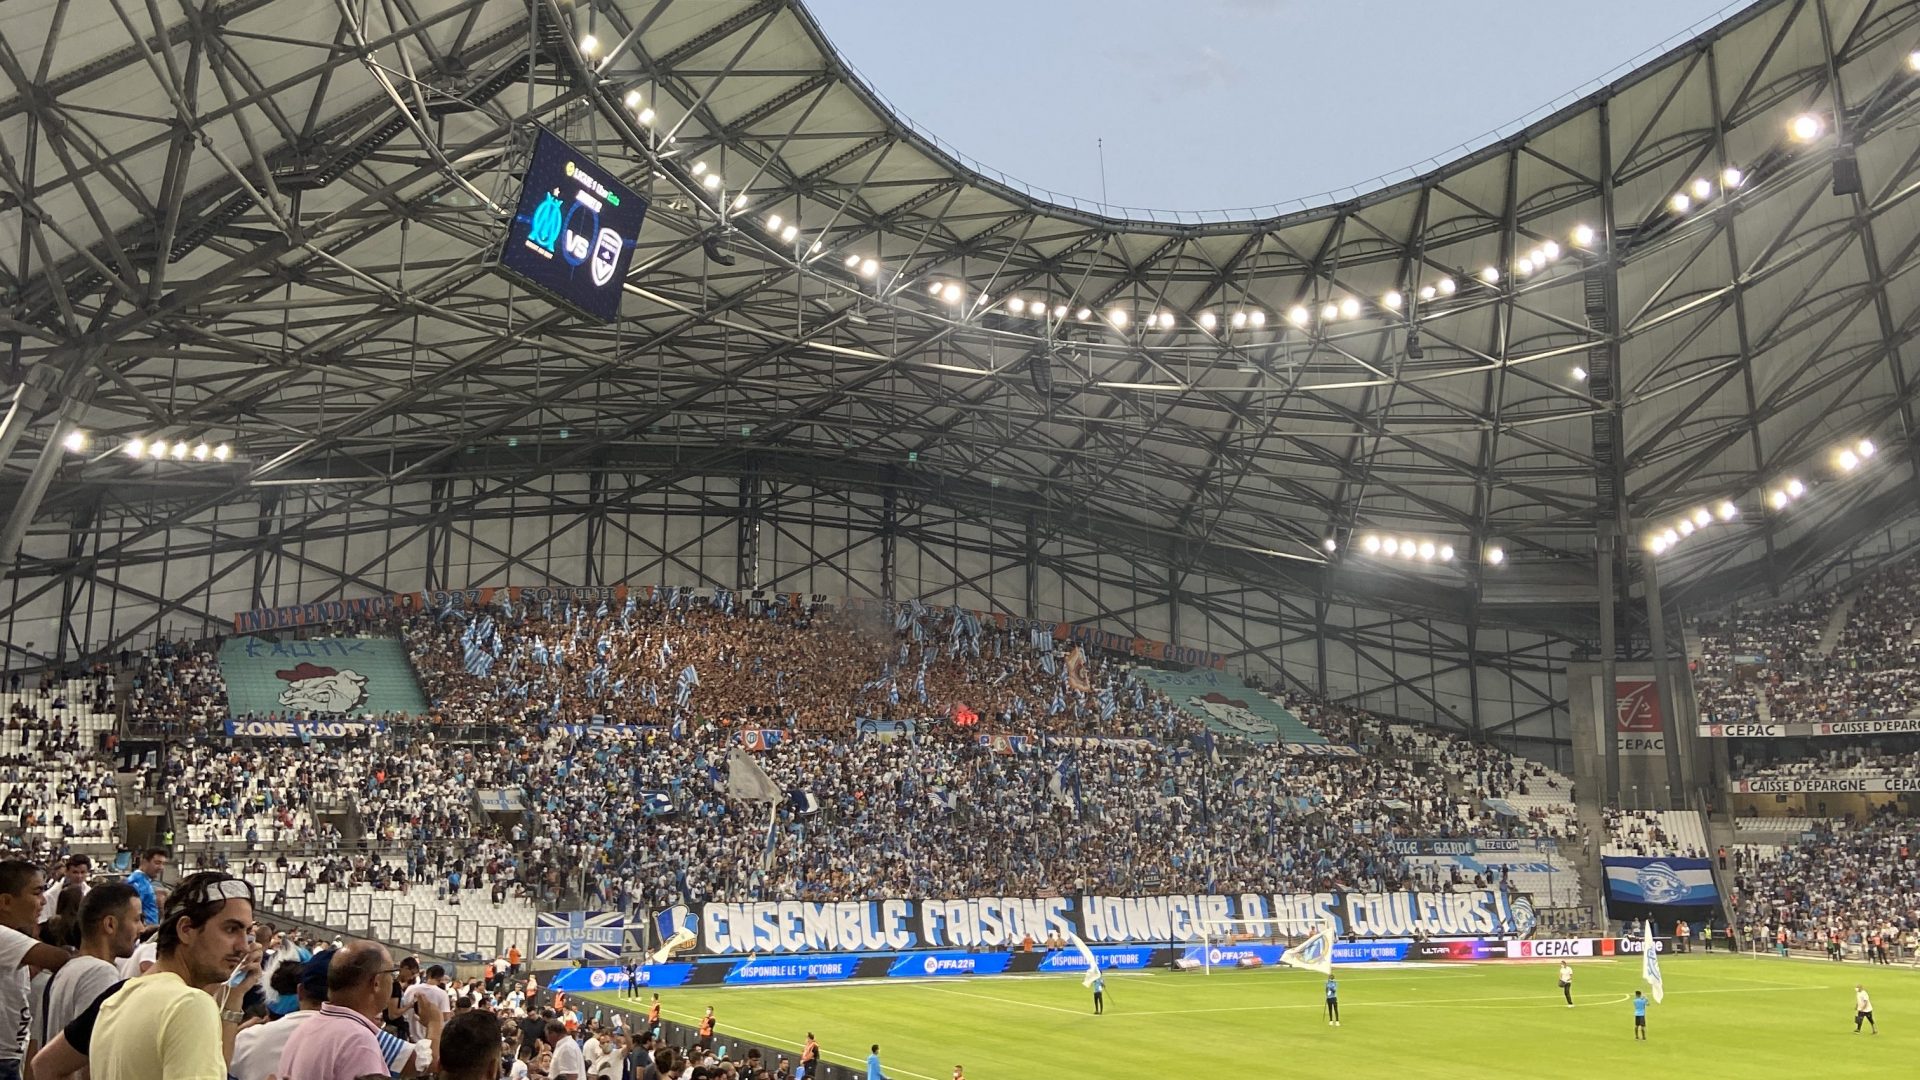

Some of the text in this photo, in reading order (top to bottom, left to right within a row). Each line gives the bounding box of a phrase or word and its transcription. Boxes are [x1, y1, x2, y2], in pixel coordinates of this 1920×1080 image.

[566, 229, 589, 259] VS
[520, 587, 613, 602] SOUTH
[1163, 644, 1220, 668] GROUP
[232, 720, 297, 737] ZONE
[1725, 724, 1775, 736] CEPAC
[1832, 720, 1920, 734] CAISSE D'EPAR
[1617, 738, 1664, 750] CEPAC
[1750, 780, 1866, 792] CAISSE D'EPARGNE
[703, 899, 912, 953] ENSEMBLE
[1082, 895, 1235, 942] HONNEUR
[1240, 893, 1266, 938] A
[1273, 893, 1338, 937] NOS
[556, 927, 613, 943] MARSEILLE
[1355, 948, 1363, 957] LE
[1371, 947, 1397, 957] OCTOBRE
[1535, 940, 1579, 956] CEPAC
[1110, 953, 1139, 964] OCTOBRE
[741, 966, 785, 977] DISPONIBLE
[787, 965, 796, 975] LE
[808, 963, 842, 974] OCTOBRE
